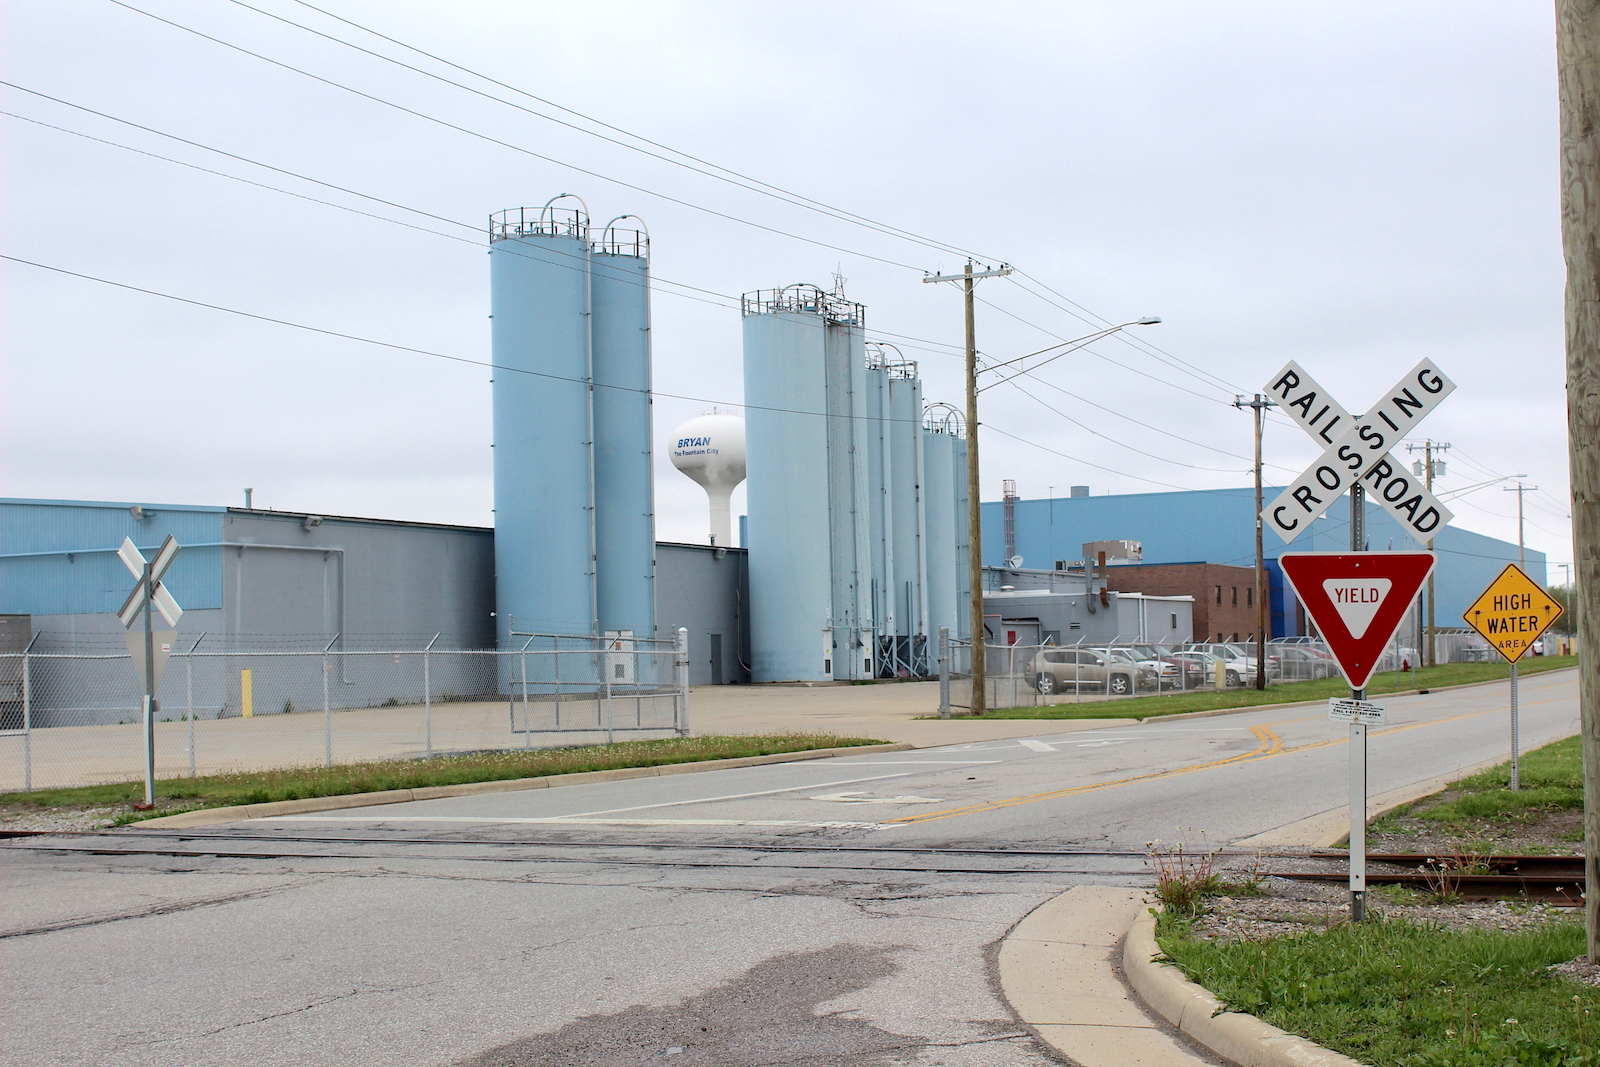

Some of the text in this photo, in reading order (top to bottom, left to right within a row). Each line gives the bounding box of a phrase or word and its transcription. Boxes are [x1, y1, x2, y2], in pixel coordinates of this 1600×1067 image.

[677, 437, 711, 448] BRYAN
[1272, 369, 1440, 533] RAIL ROAD
[1273, 369, 1444, 531] CROSSING
[1335, 588, 1379, 603] YIELD
[1493, 593, 1531, 611] HIGH
[1487, 616, 1538, 634] WATER
[1498, 639, 1527, 649] AREA
